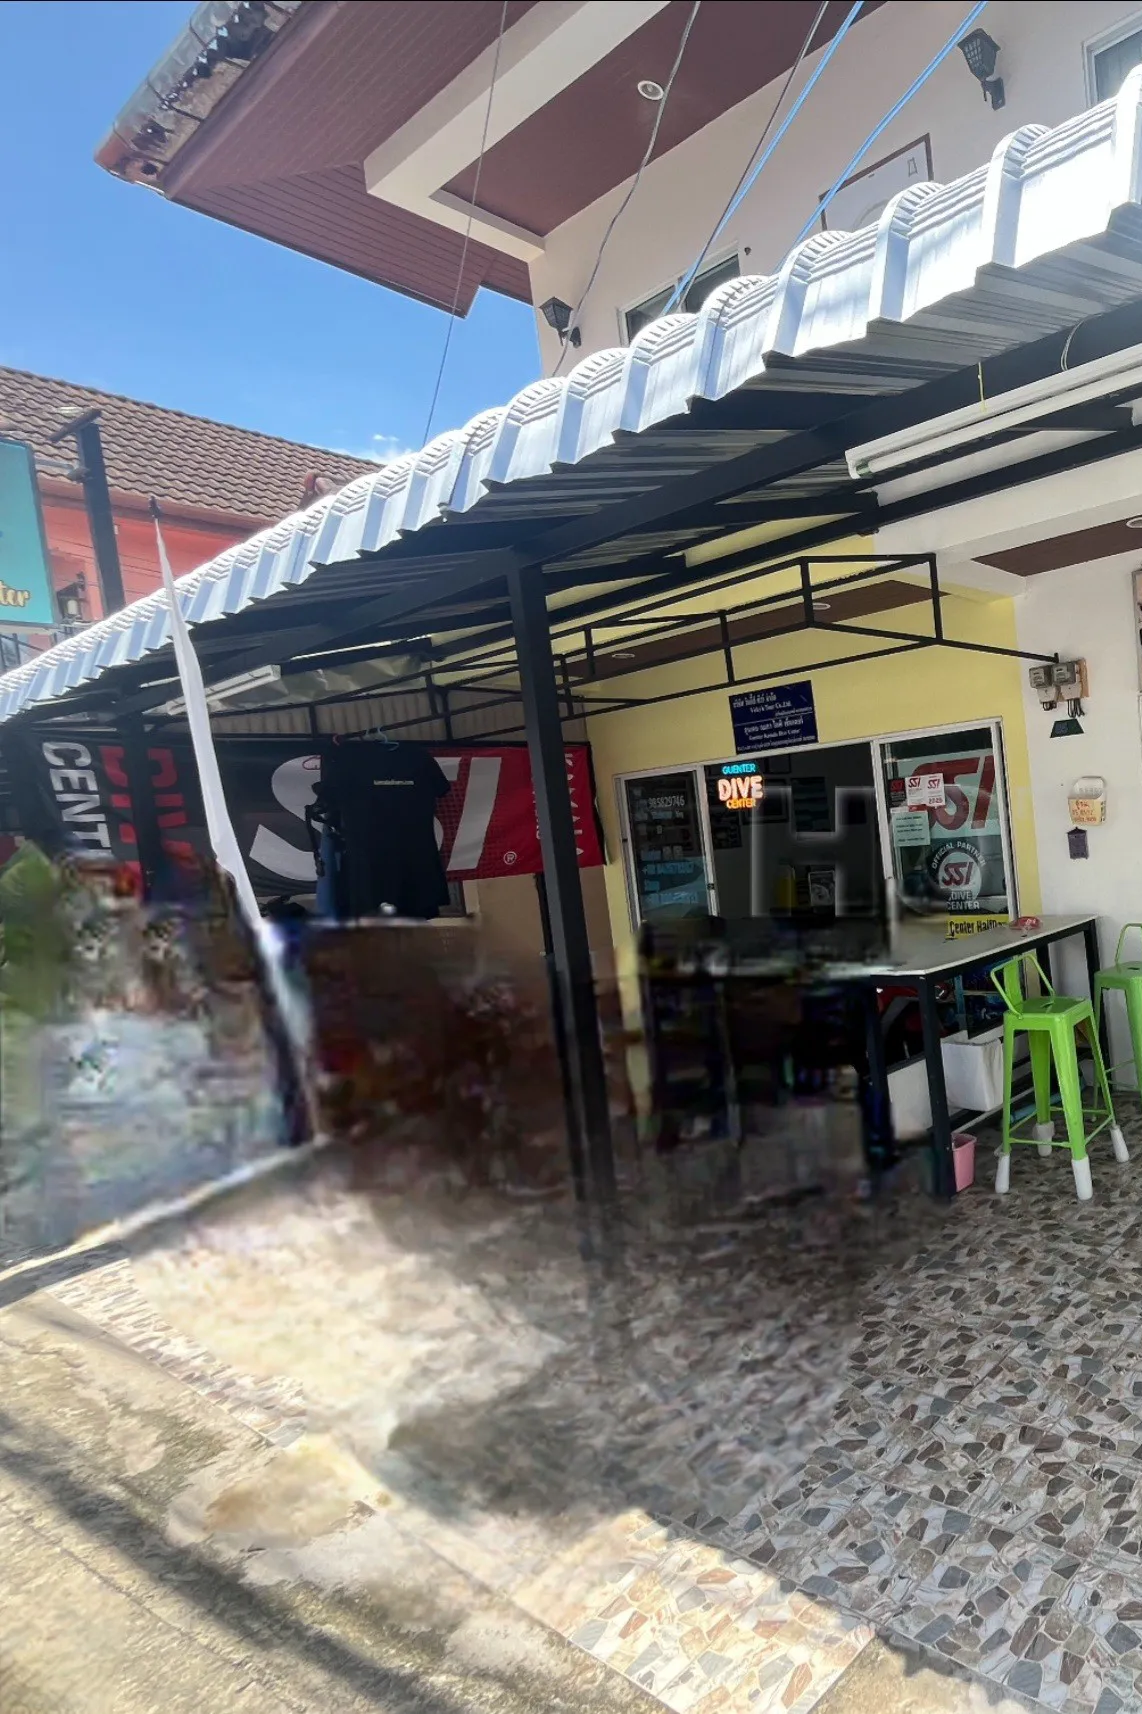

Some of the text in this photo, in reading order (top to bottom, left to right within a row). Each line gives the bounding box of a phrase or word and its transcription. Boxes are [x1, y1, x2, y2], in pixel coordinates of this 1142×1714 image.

[722, 763, 756, 775] GUENTER
[718, 776, 764, 801] DIVE
[726, 797, 757, 809] CENTER
[941, 862, 974, 886] SSI
[951, 891, 972, 900] DIVE
[946, 901, 980, 910] CENTER
